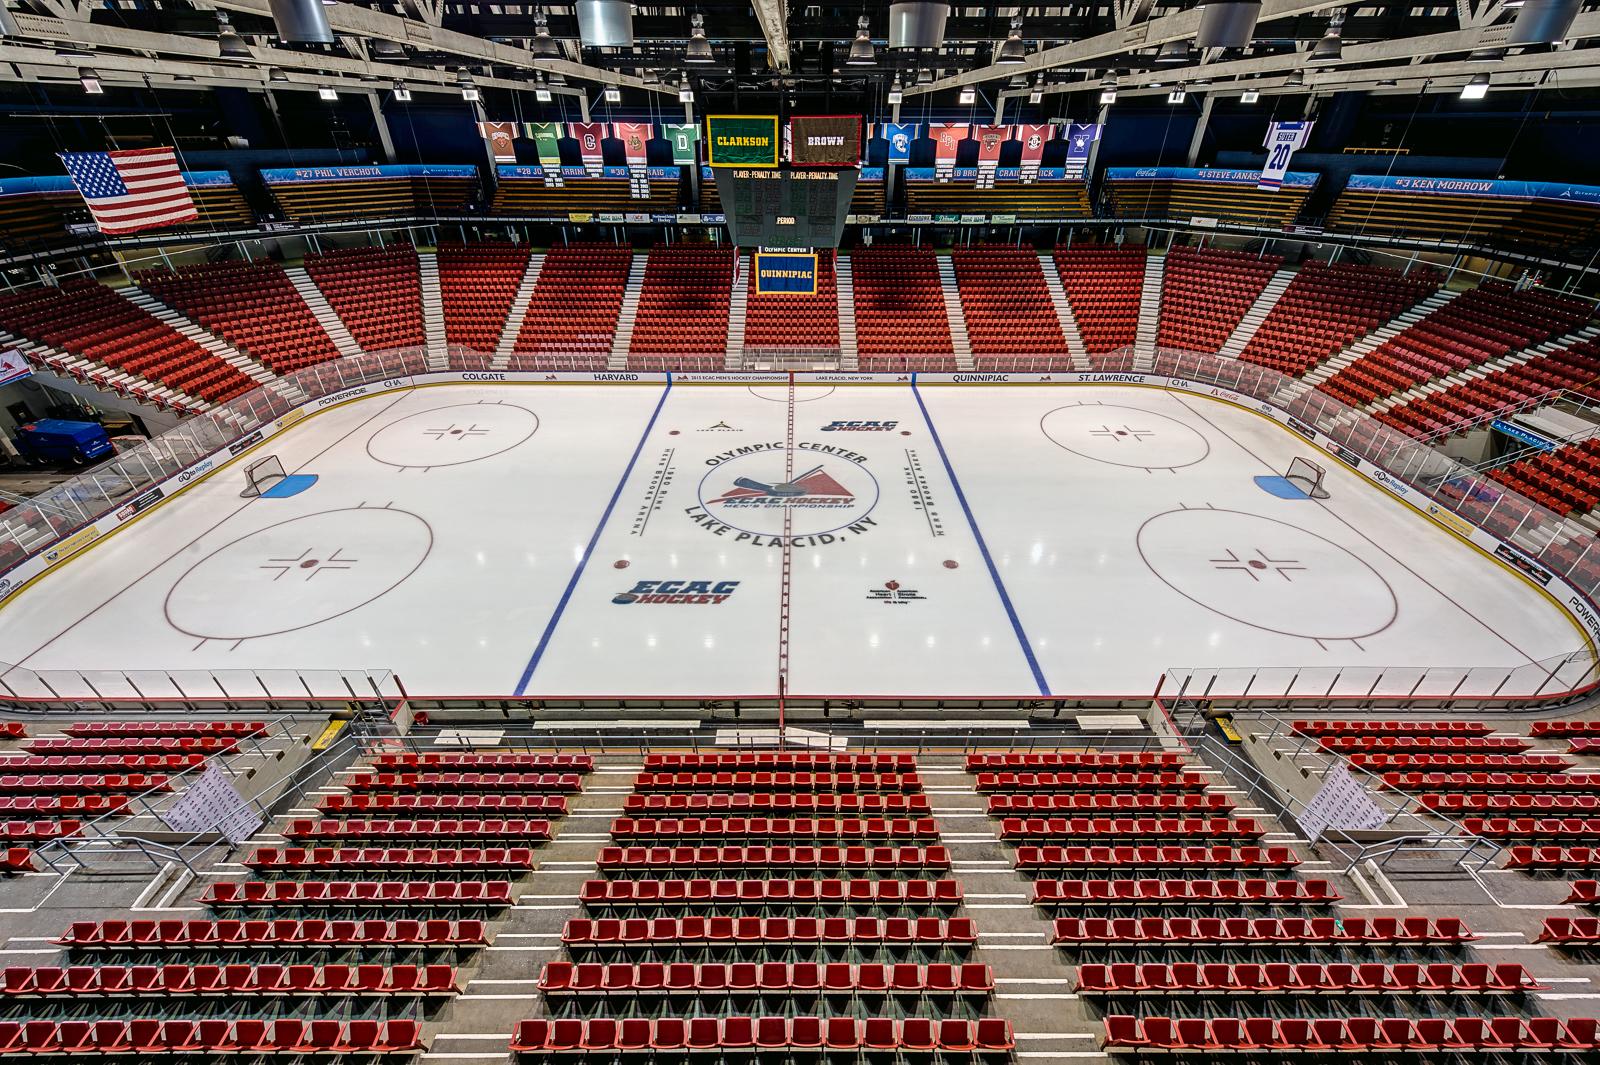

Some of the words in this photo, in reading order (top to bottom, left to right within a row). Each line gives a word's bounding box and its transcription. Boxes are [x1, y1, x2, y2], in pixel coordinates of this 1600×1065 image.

[717, 136, 769, 147] CLARKSON
[807, 136, 845, 146] BROWN
[1278, 132, 1296, 141] SUTER
[1268, 144, 1291, 170] 20
[295, 169, 313, 179] #27
[315, 168, 335, 178] PHIL
[610, 168, 625, 176] #30
[1135, 169, 1157, 177] Coca-Cola
[1206, 170, 1231, 179] STEVE
[1232, 172, 1261, 180] JANASZ
[1395, 179, 1410, 188] #3
[1411, 179, 1436, 189] KEN
[1437, 180, 1494, 192] MORROW
[777, 217, 795, 225] PERIOD
[760, 269, 812, 279] QUINNIPIAC
[462, 373, 506, 381] COLGATE
[594, 373, 639, 381] HARVARD
[952, 374, 1009, 383] QUINNIPIAC
[1078, 374, 1092, 382] ST.
[1093, 375, 1145, 383] LAWRENCE
[318, 387, 368, 407] POWERADE
[1503, 425, 1519, 436] LAKE
[705, 441, 784, 467] OLYMPIC
[798, 442, 867, 464] CENTER
[195, 460, 213, 473] Replay
[1390, 479, 1409, 495] Replay
[684, 505, 731, 536] LAKE
[847, 516, 879, 535] NY
[628, 580, 740, 594] ECAC
[635, 594, 731, 604] HOCKEY
